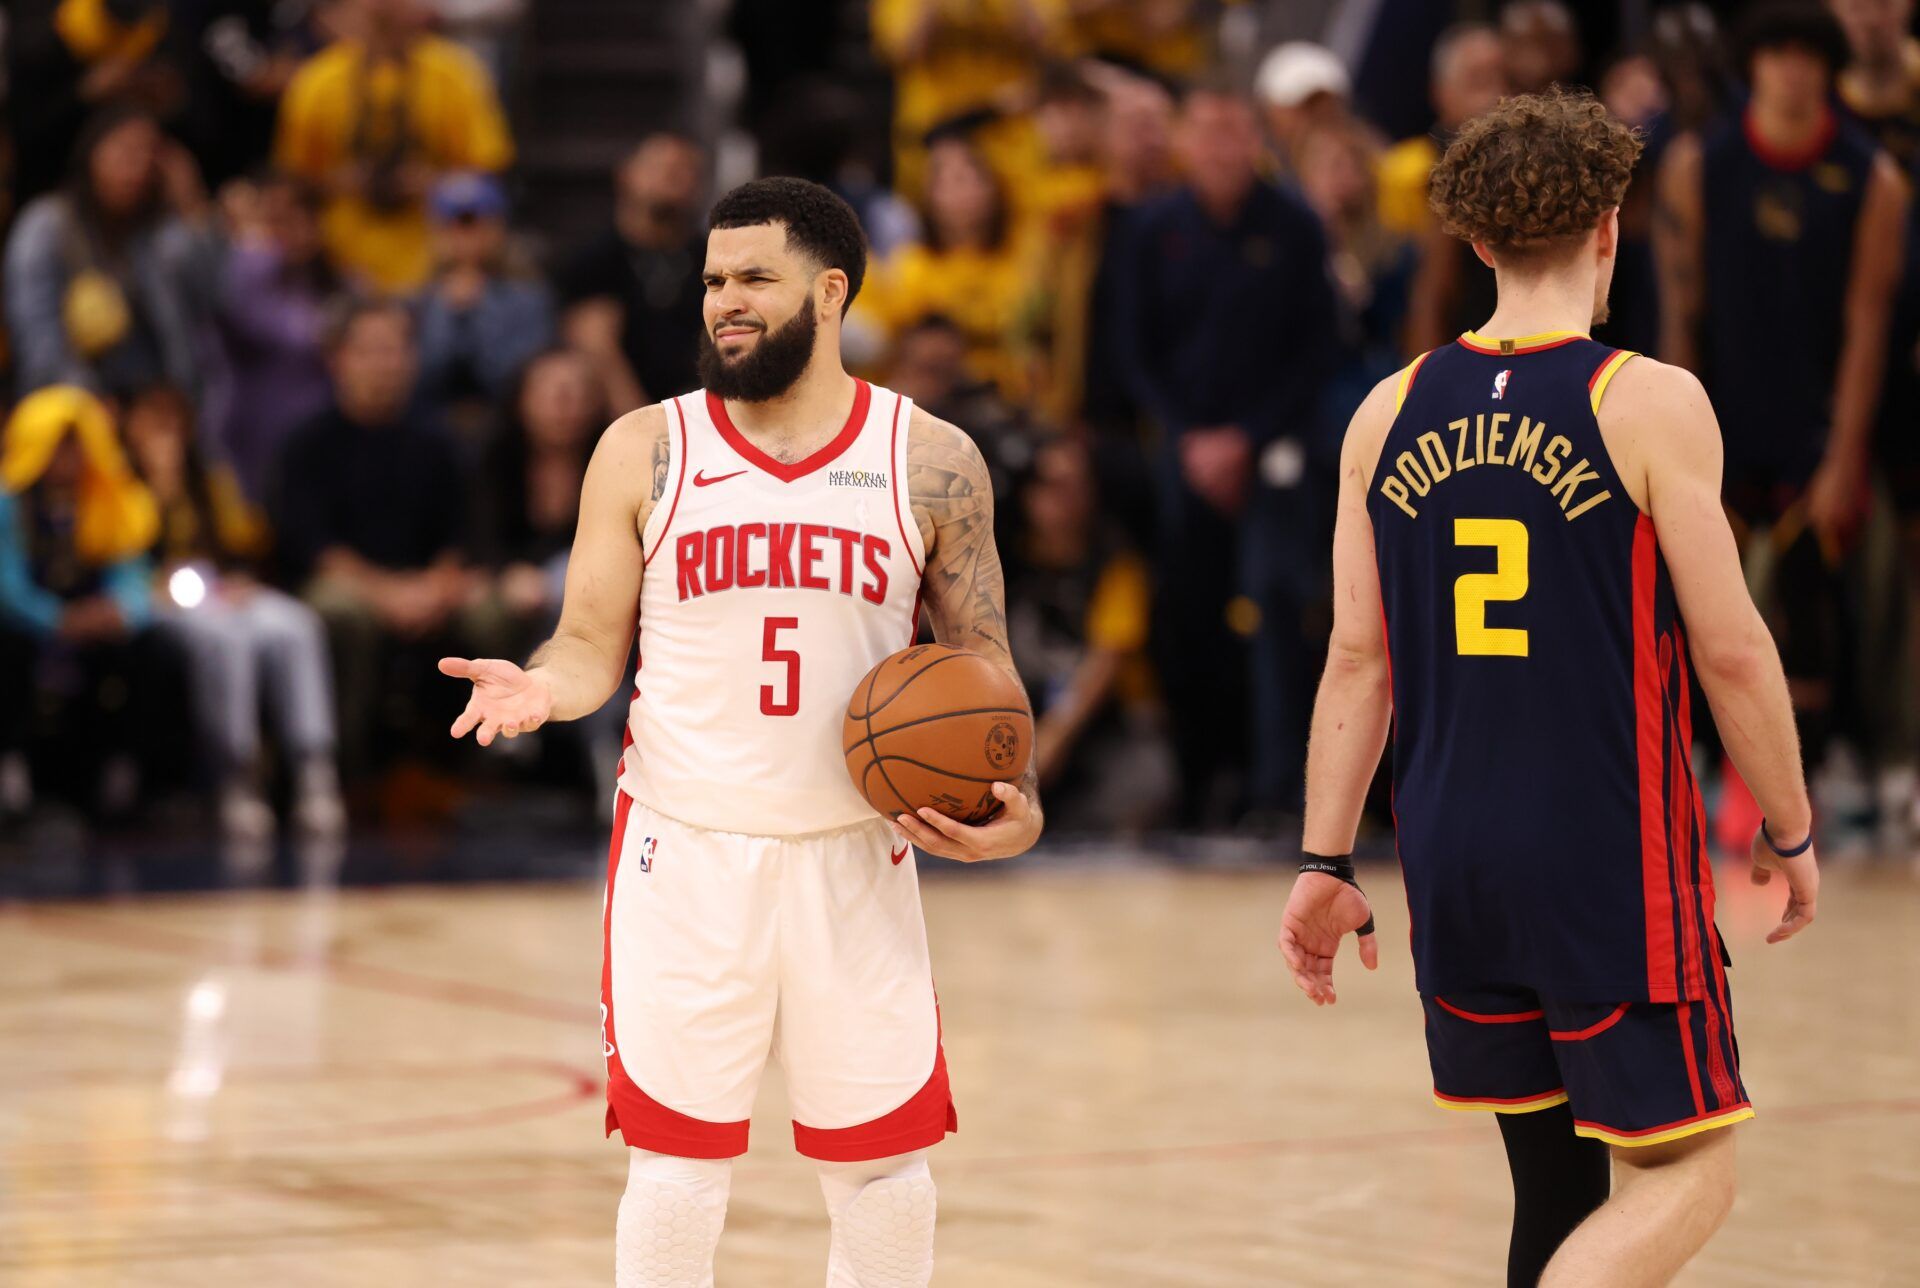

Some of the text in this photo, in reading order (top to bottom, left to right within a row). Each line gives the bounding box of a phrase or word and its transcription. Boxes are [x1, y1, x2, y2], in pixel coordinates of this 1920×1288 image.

[829, 470, 886, 481] MEMORIAL
[829, 477, 887, 488] HERMANN
[1380, 412, 1612, 521] PODZIEMSKI
[675, 521, 892, 606] ROCKETS
[1454, 518, 1528, 657] 2
[759, 616, 801, 717] 5
